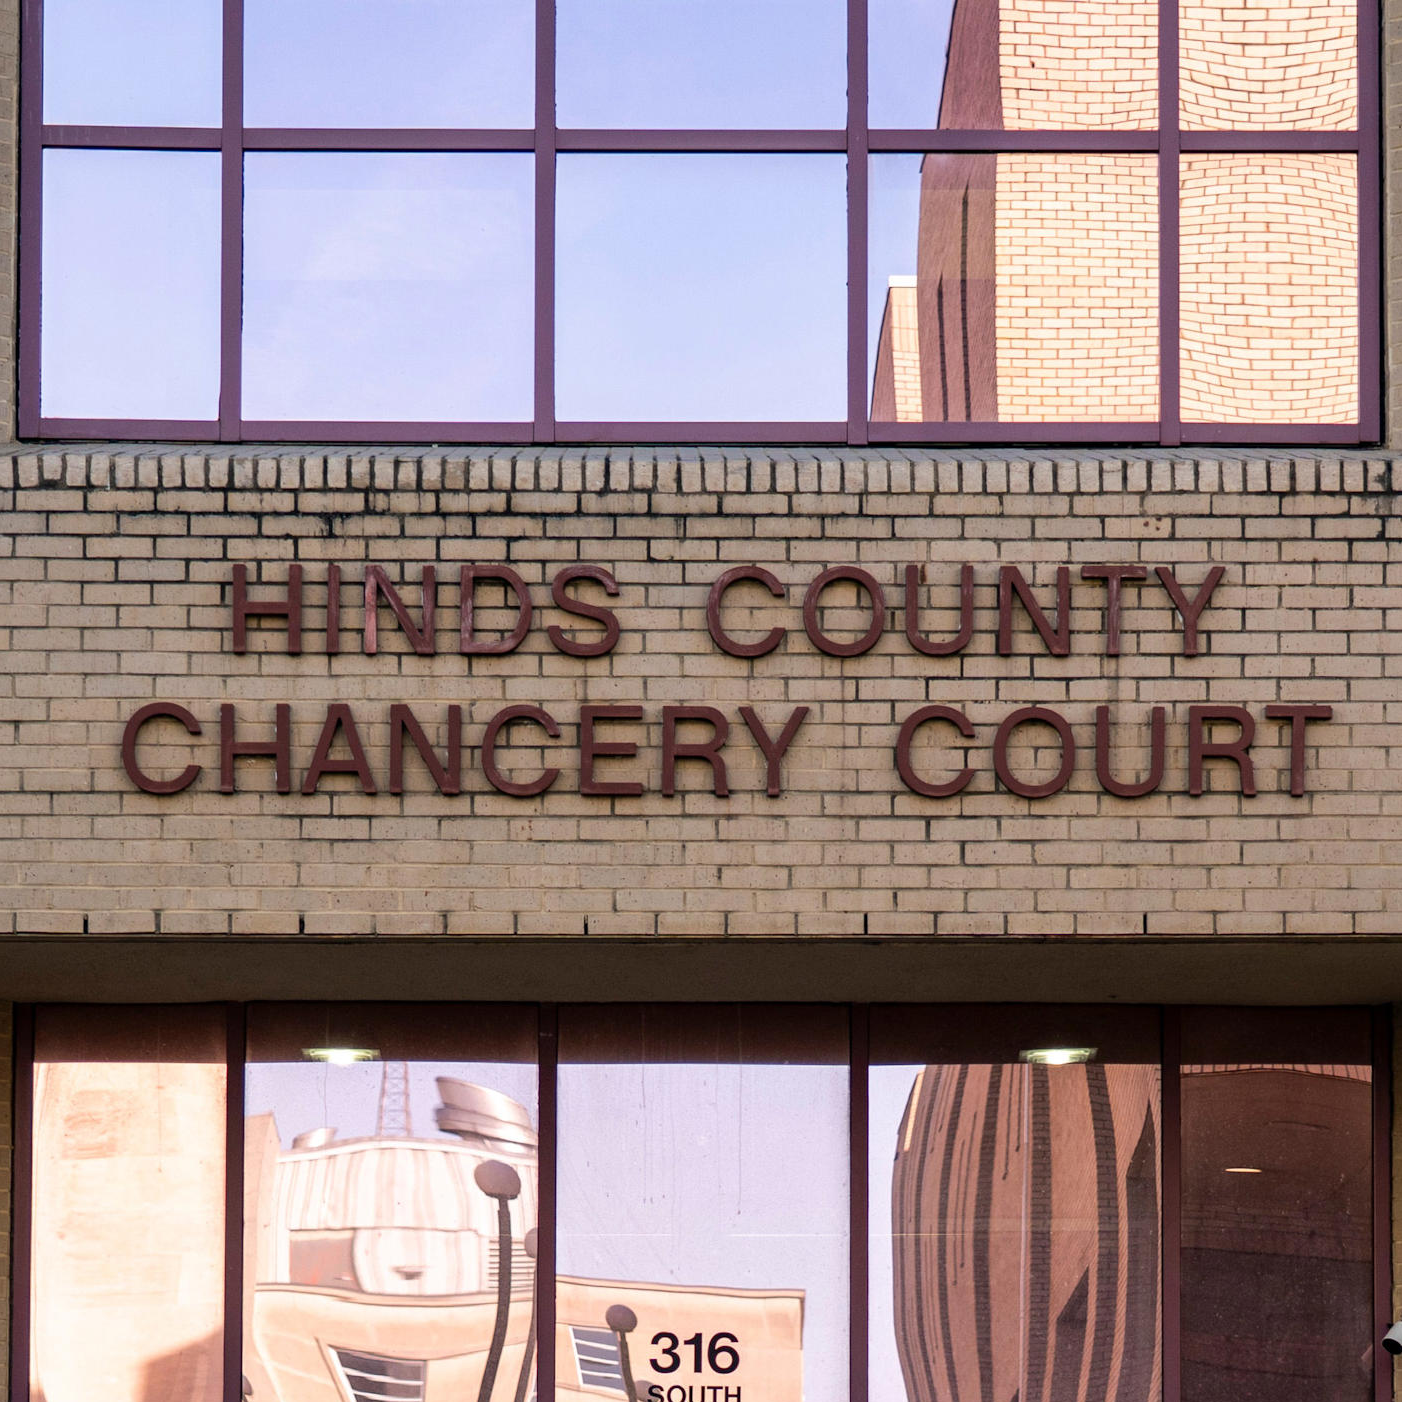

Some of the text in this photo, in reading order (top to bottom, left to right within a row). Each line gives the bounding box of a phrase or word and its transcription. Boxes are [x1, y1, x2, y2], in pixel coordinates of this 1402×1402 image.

[231, 562, 1226, 659] HINDS COUNTY
[120, 700, 1335, 798] CHANCERY COURT
[649, 1331, 741, 1375] 316
